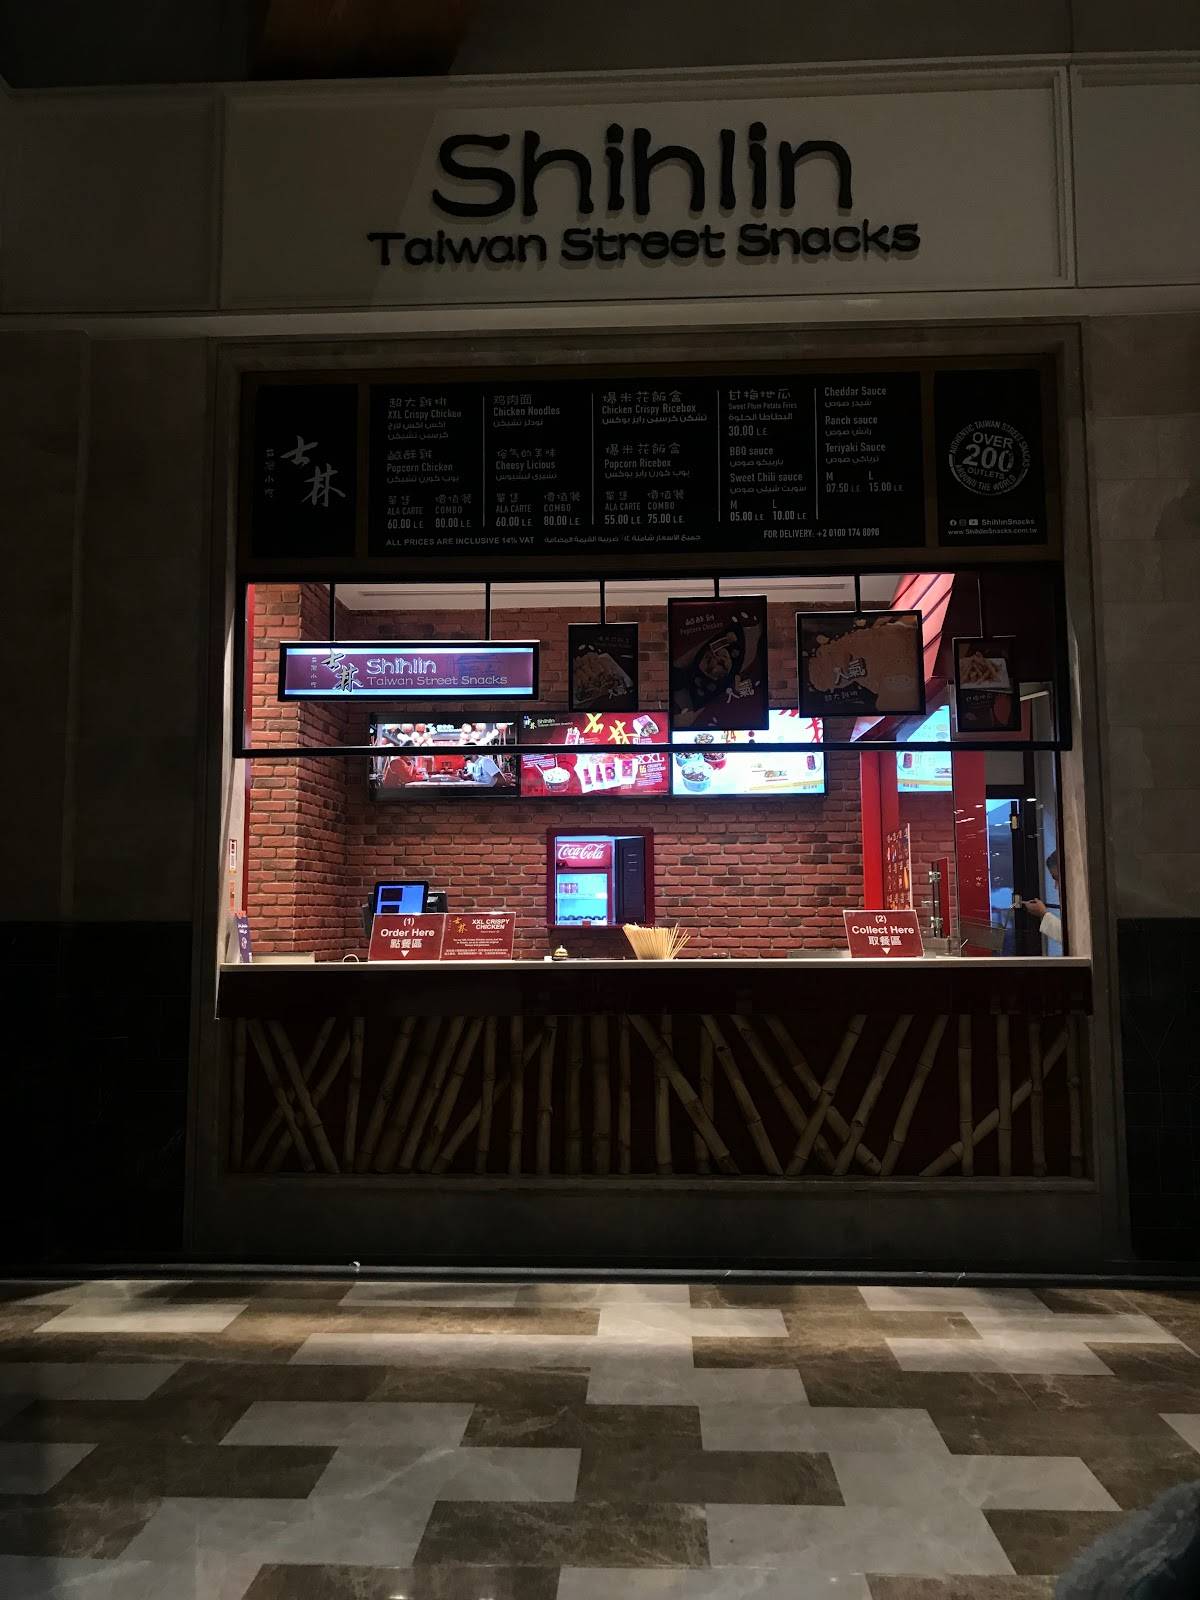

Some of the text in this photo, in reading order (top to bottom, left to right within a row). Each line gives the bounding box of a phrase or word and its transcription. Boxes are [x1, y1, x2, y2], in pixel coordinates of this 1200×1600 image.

[432, 122, 853, 217] Shihlin
[367, 219, 921, 266] Taiwan Street Snacks
[824, 385, 887, 397] Cheddar Sauce
[493, 405, 561, 417] Chicken Noodles
[601, 403, 697, 415] Chicken Crispy Ricebox
[404, 410, 428, 421] Crispy
[825, 415, 878, 426] Ranch sauce
[974, 419, 1001, 429] TAIWAN
[728, 424, 754, 437] 30.00
[972, 432, 1014, 450] OVER
[729, 446, 774, 456] BBQ sauce
[825, 441, 887, 455] Teriyaki Sauce
[962, 443, 1015, 472] 200
[386, 461, 453, 473] Popcorn Chicken
[495, 460, 556, 471] Cheesy Licious
[604, 458, 672, 470] Popcorn Ricebox
[729, 472, 803, 483] Sweet Chili sauce
[826, 470, 874, 481] M L
[967, 466, 1005, 480] OUTLETS
[826, 482, 849, 493] 07.50
[868, 481, 892, 492] 15.00
[978, 481, 991, 491] THE
[435, 505, 463, 514] COMBO
[544, 503, 572, 512] COMBO
[619, 502, 640, 511] CARTE
[647, 501, 675, 511] COMBO
[730, 498, 778, 510] M L
[543, 515, 567, 526] 80.00
[604, 513, 629, 525] 55.00
[647, 513, 671, 524] 75.00
[730, 511, 753, 521] 05.00
[772, 510, 795, 520] 10.00
[387, 518, 411, 529] 60.00
[435, 517, 459, 528] 80.00
[495, 516, 519, 527] 60.00
[763, 529, 778, 538] FOR
[828, 528, 846, 537] 0100
[848, 528, 861, 537] 174
[386, 538, 402, 546] ALL
[404, 537, 435, 546] PRICES
[436, 537, 454, 545] ARE
[455, 537, 500, 545] INCLUSIVE
[519, 536, 535, 544] VAT
[366, 657, 437, 676] Shihlin
[367, 674, 508, 687] Taiwan Street Snacks
[636, 753, 665, 764] XXL
[403, 917, 415, 927] (1)
[875, 914, 887, 924] (2)
[380, 929, 435, 937] Order Here
[851, 925, 915, 935] Collect Here
[868, 936, 903, 946] 取餐區
